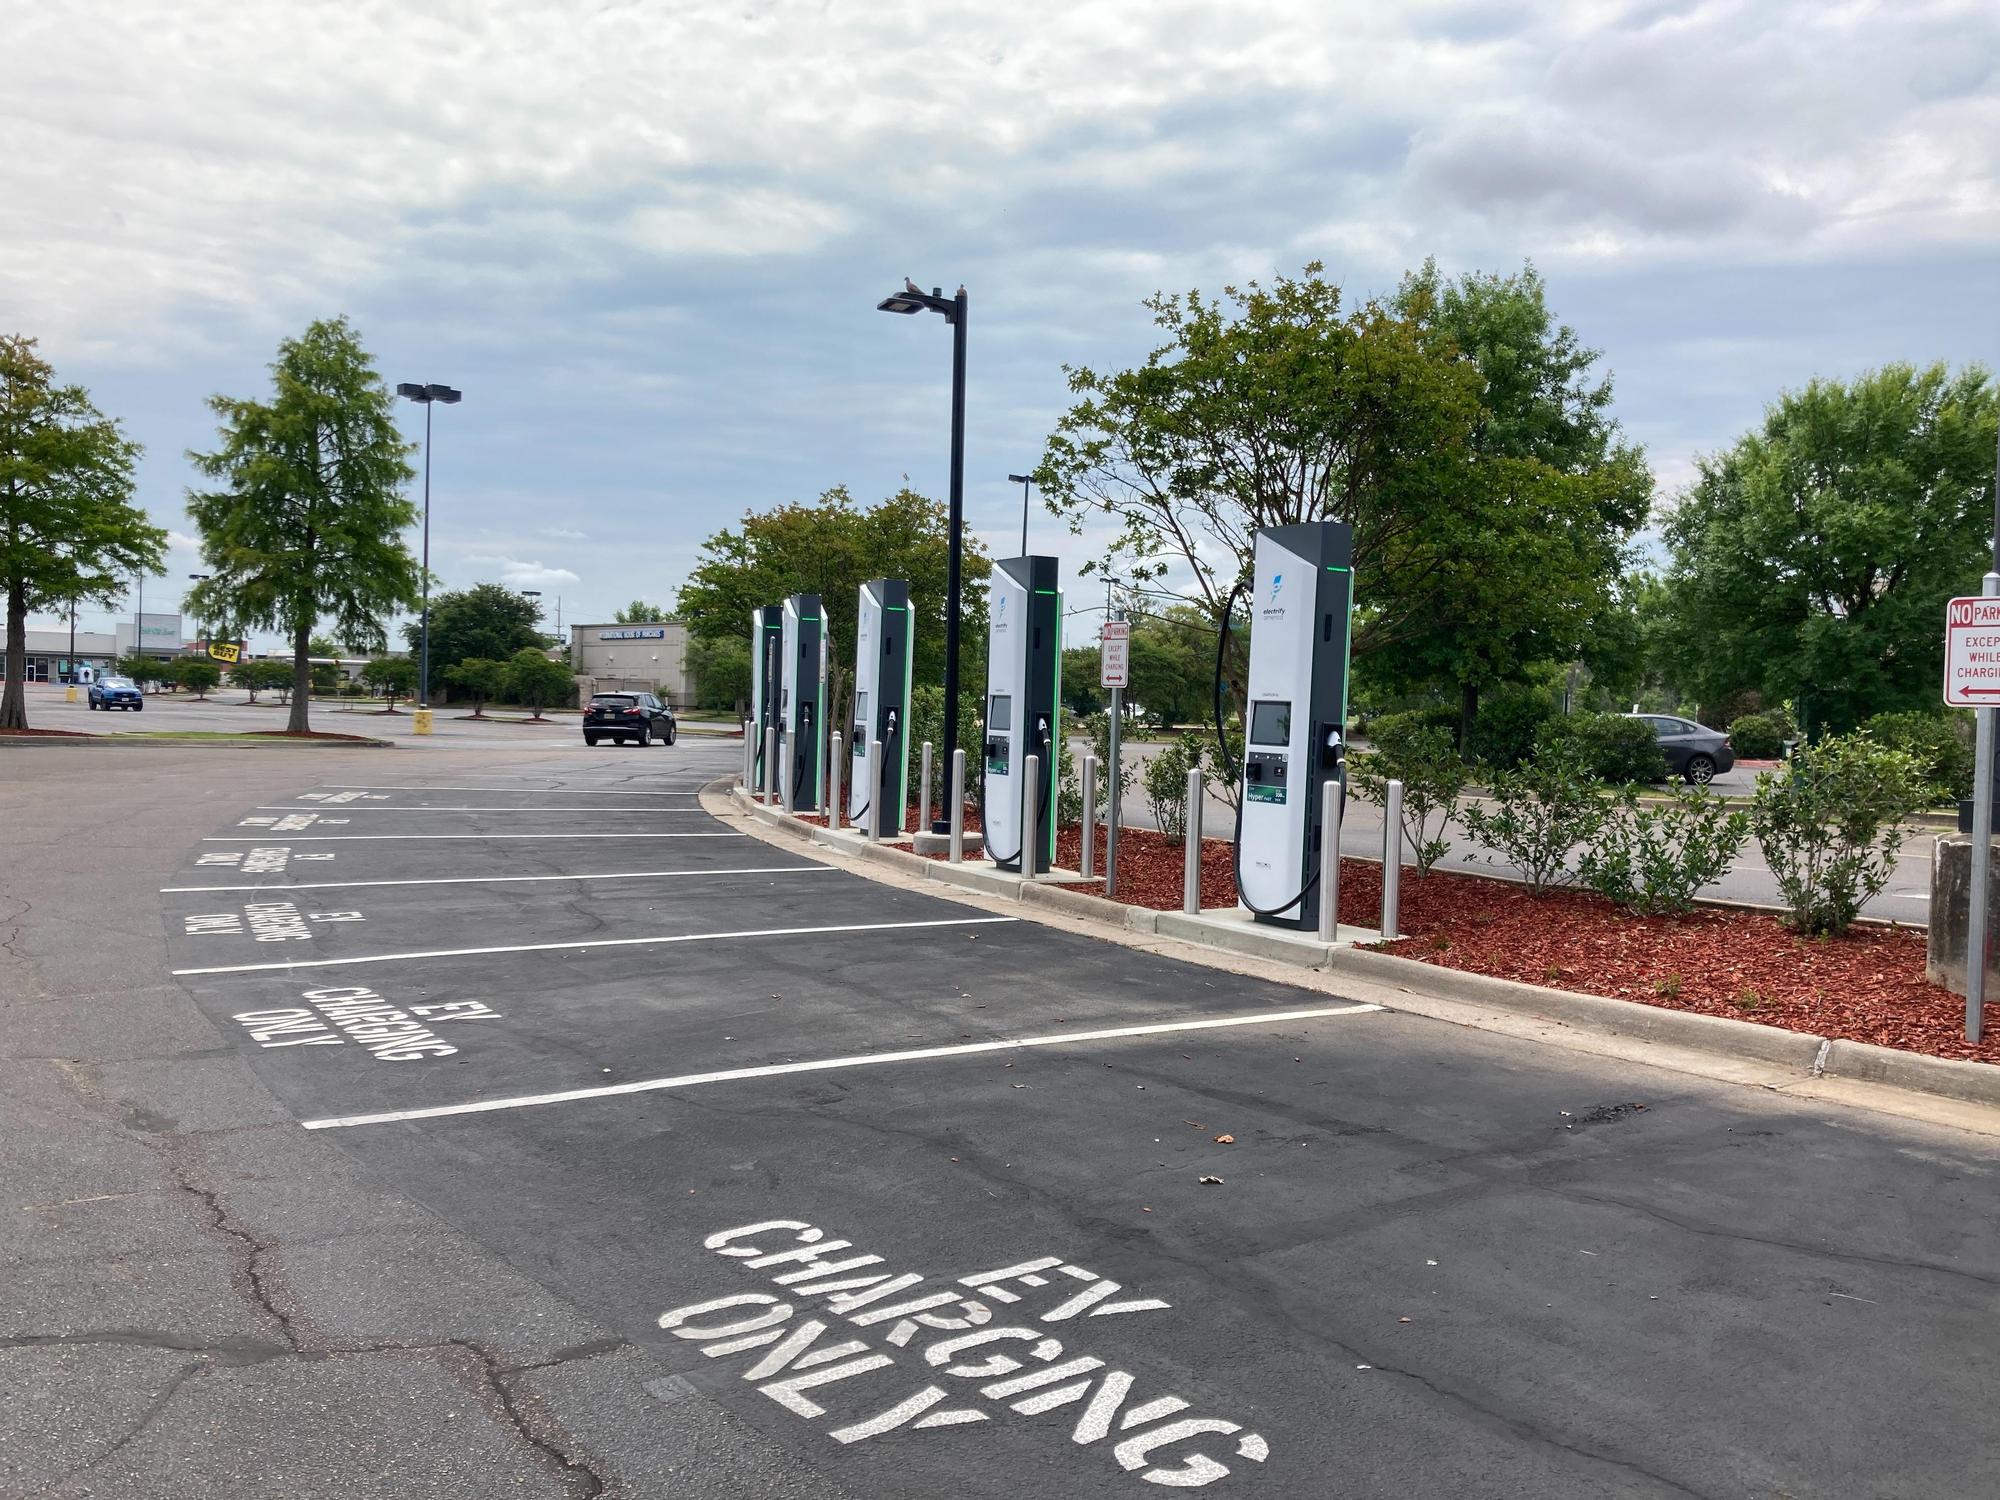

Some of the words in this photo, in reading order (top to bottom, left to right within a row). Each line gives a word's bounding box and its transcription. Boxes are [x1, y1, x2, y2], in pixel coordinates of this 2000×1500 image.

[1951, 604, 1972, 624] NO
[1957, 667, 2000, 678] CHARGI
[1969, 652, 2000, 662] WHILE
[231, 1008, 345, 1048] ONLY
[302, 986, 458, 1062] CHARGING
[408, 1000, 503, 1022] EV
[957, 1256, 1173, 1322] EV
[657, 1293, 991, 1445] ONLY
[704, 1219, 1270, 1487] CHARGING
